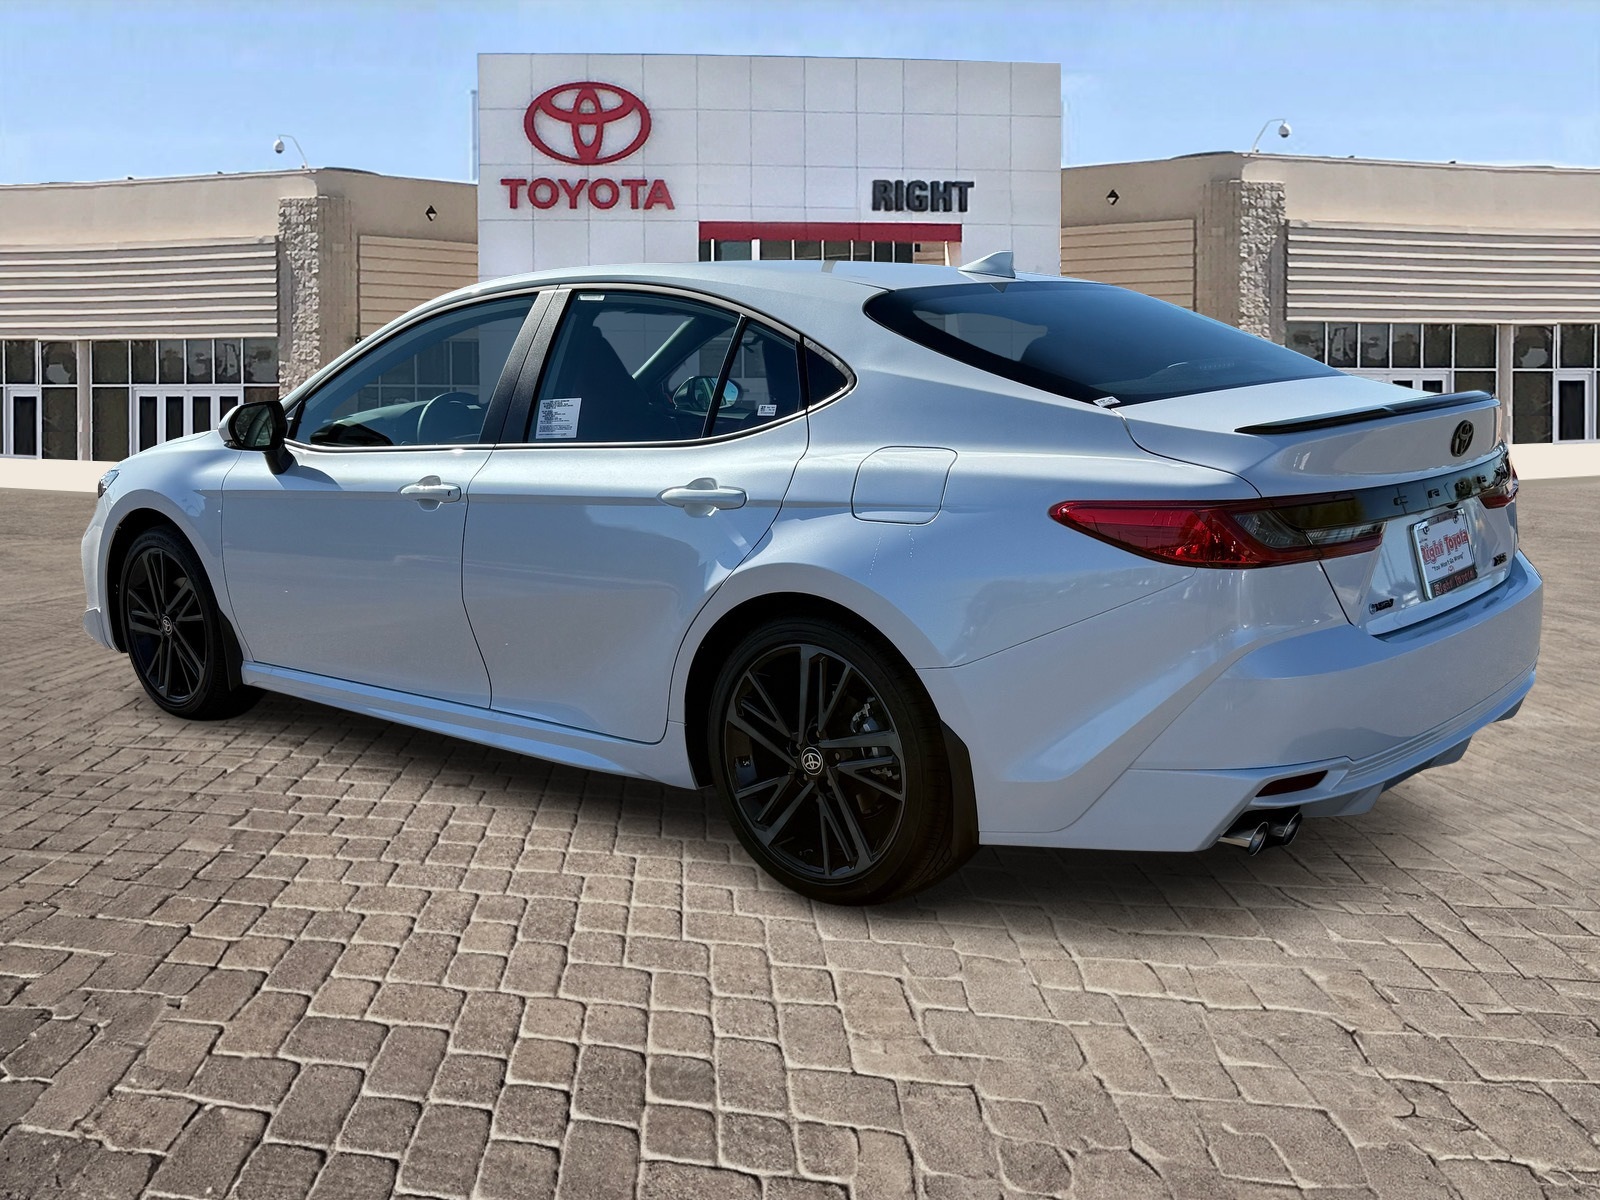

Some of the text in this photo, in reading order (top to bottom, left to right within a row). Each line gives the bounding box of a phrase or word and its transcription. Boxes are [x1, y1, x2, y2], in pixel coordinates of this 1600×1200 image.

[500, 178, 675, 209] TOYOTA
[872, 179, 975, 212] RIGHT
[1421, 529, 1469, 564] Right Toyota
